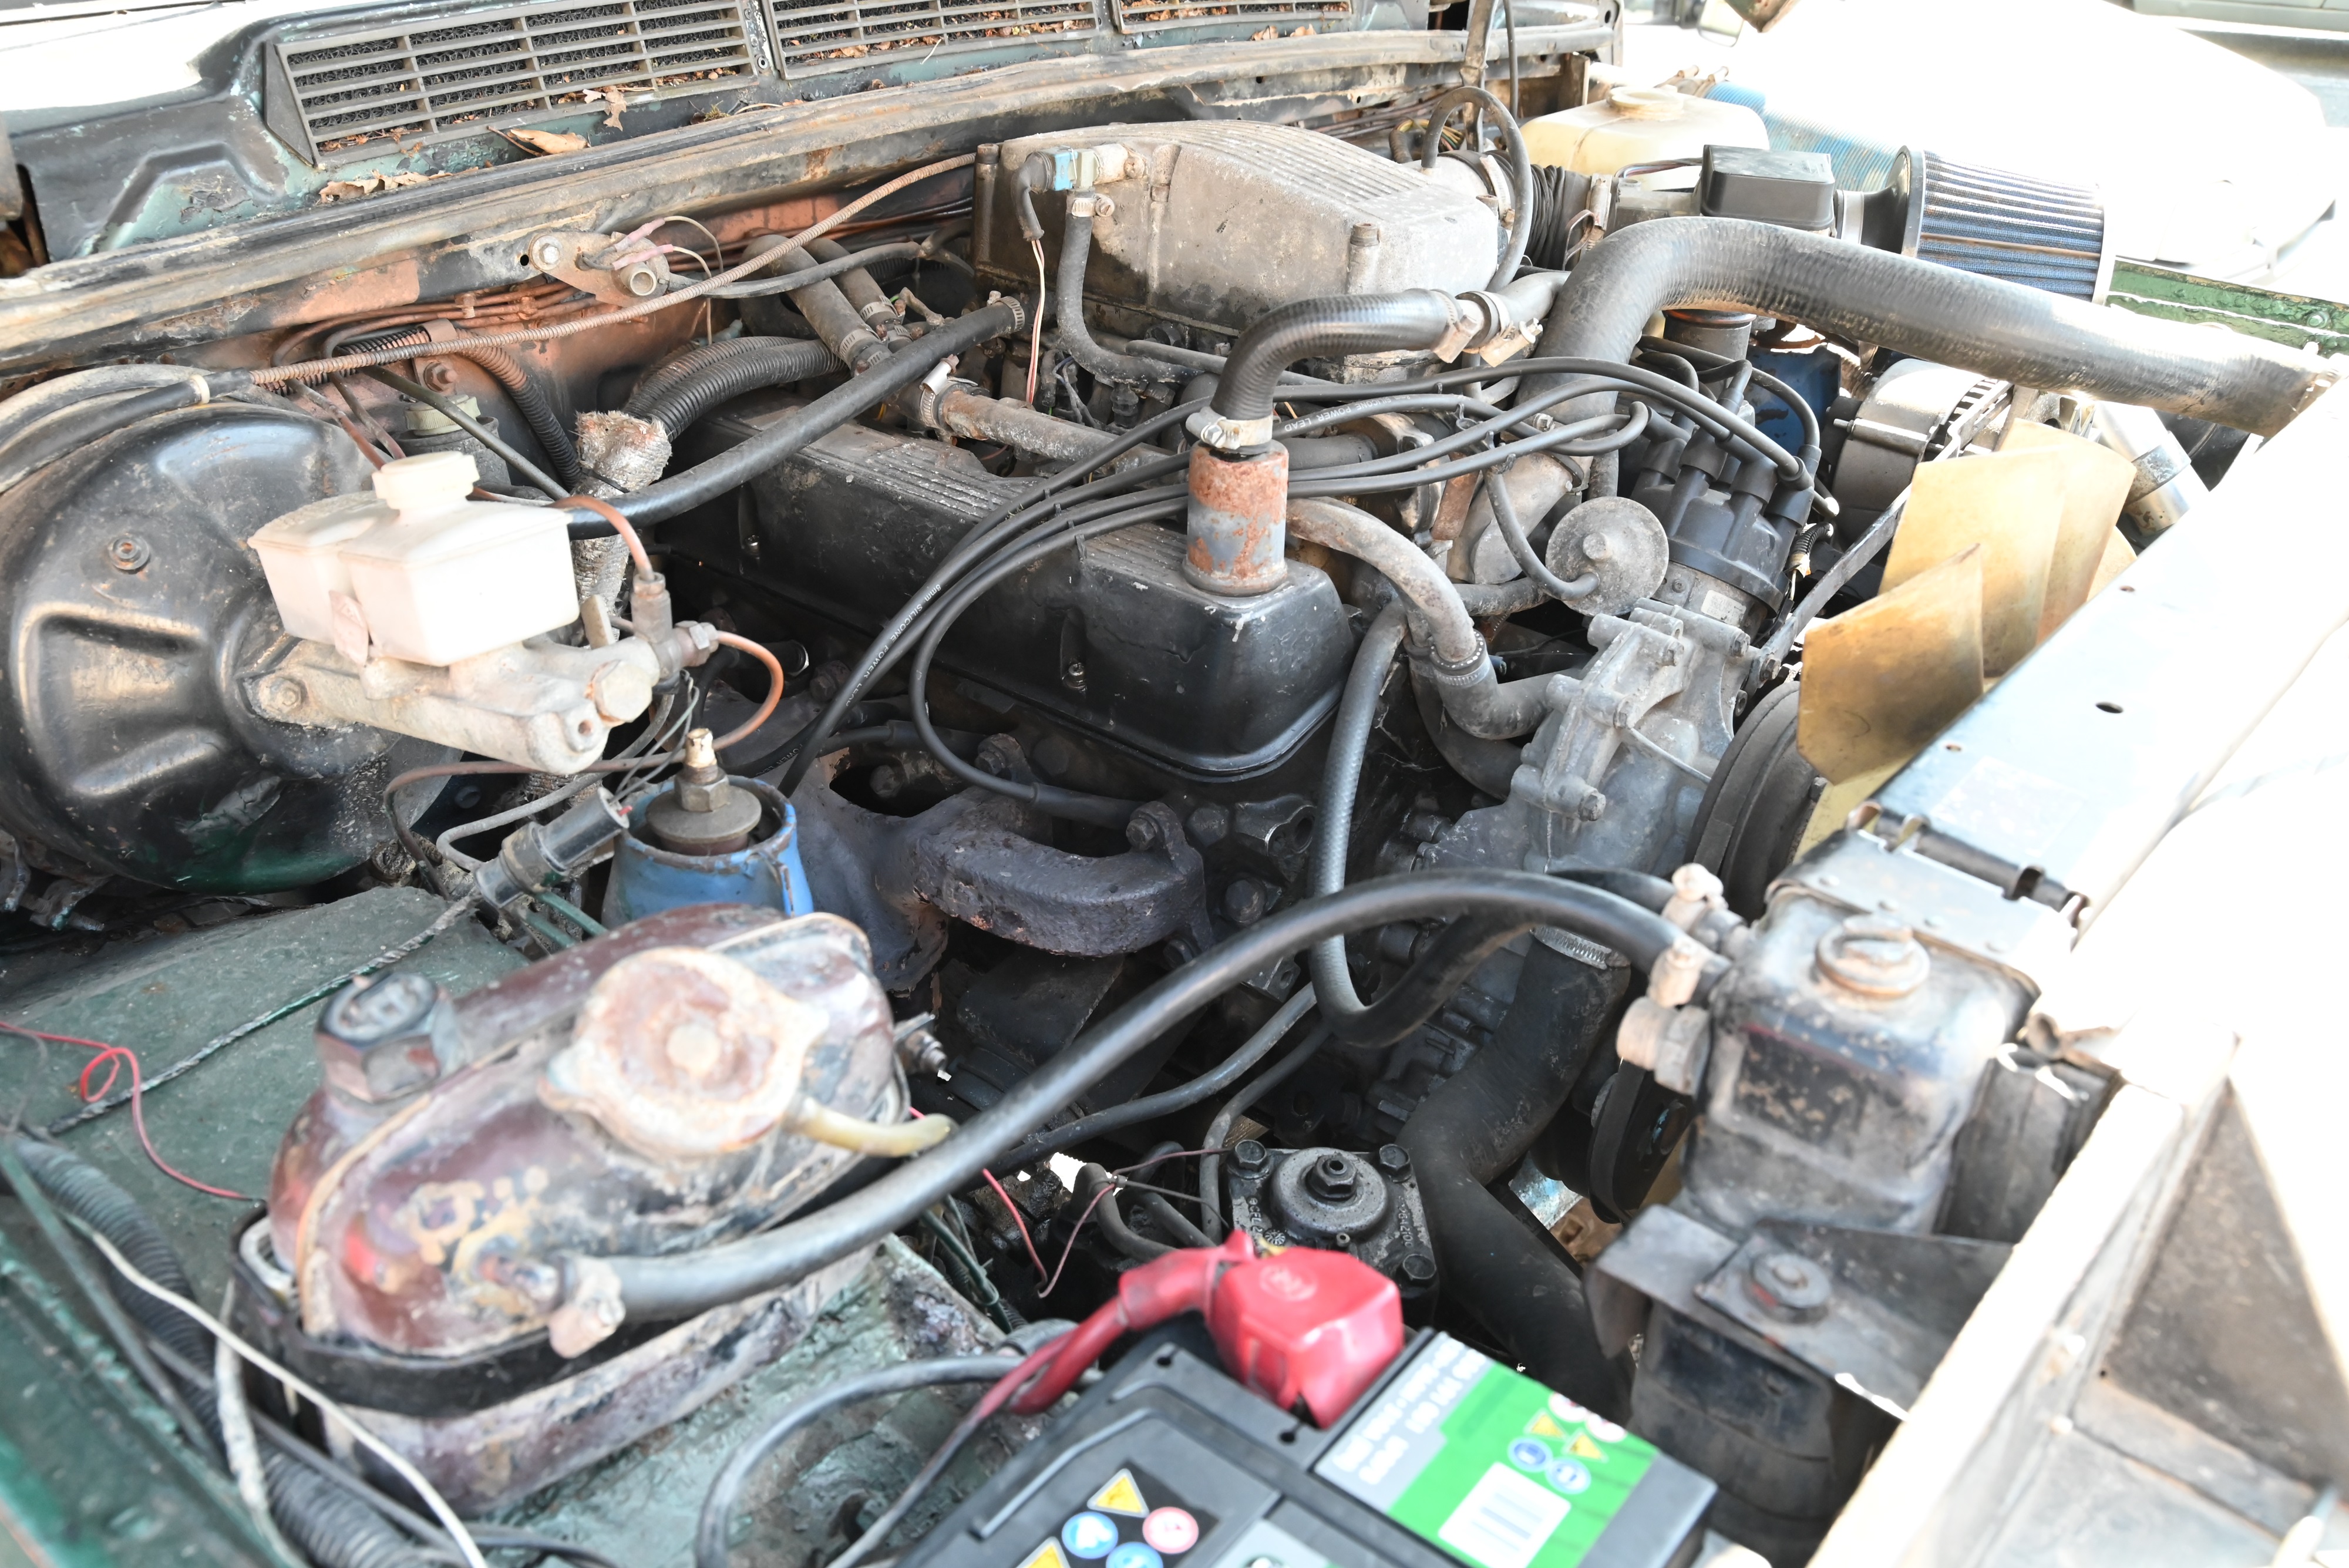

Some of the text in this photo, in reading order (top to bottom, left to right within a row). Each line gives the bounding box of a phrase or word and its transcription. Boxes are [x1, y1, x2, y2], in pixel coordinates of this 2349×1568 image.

[1354, 397, 1391, 410] SILICONE
[1316, 406, 1351, 422] POWER
[1284, 418, 1312, 432] LEAD
[924, 584, 941, 601] 8mm
[890, 604, 923, 642] SILICONE
[863, 645, 889, 678] POWER
